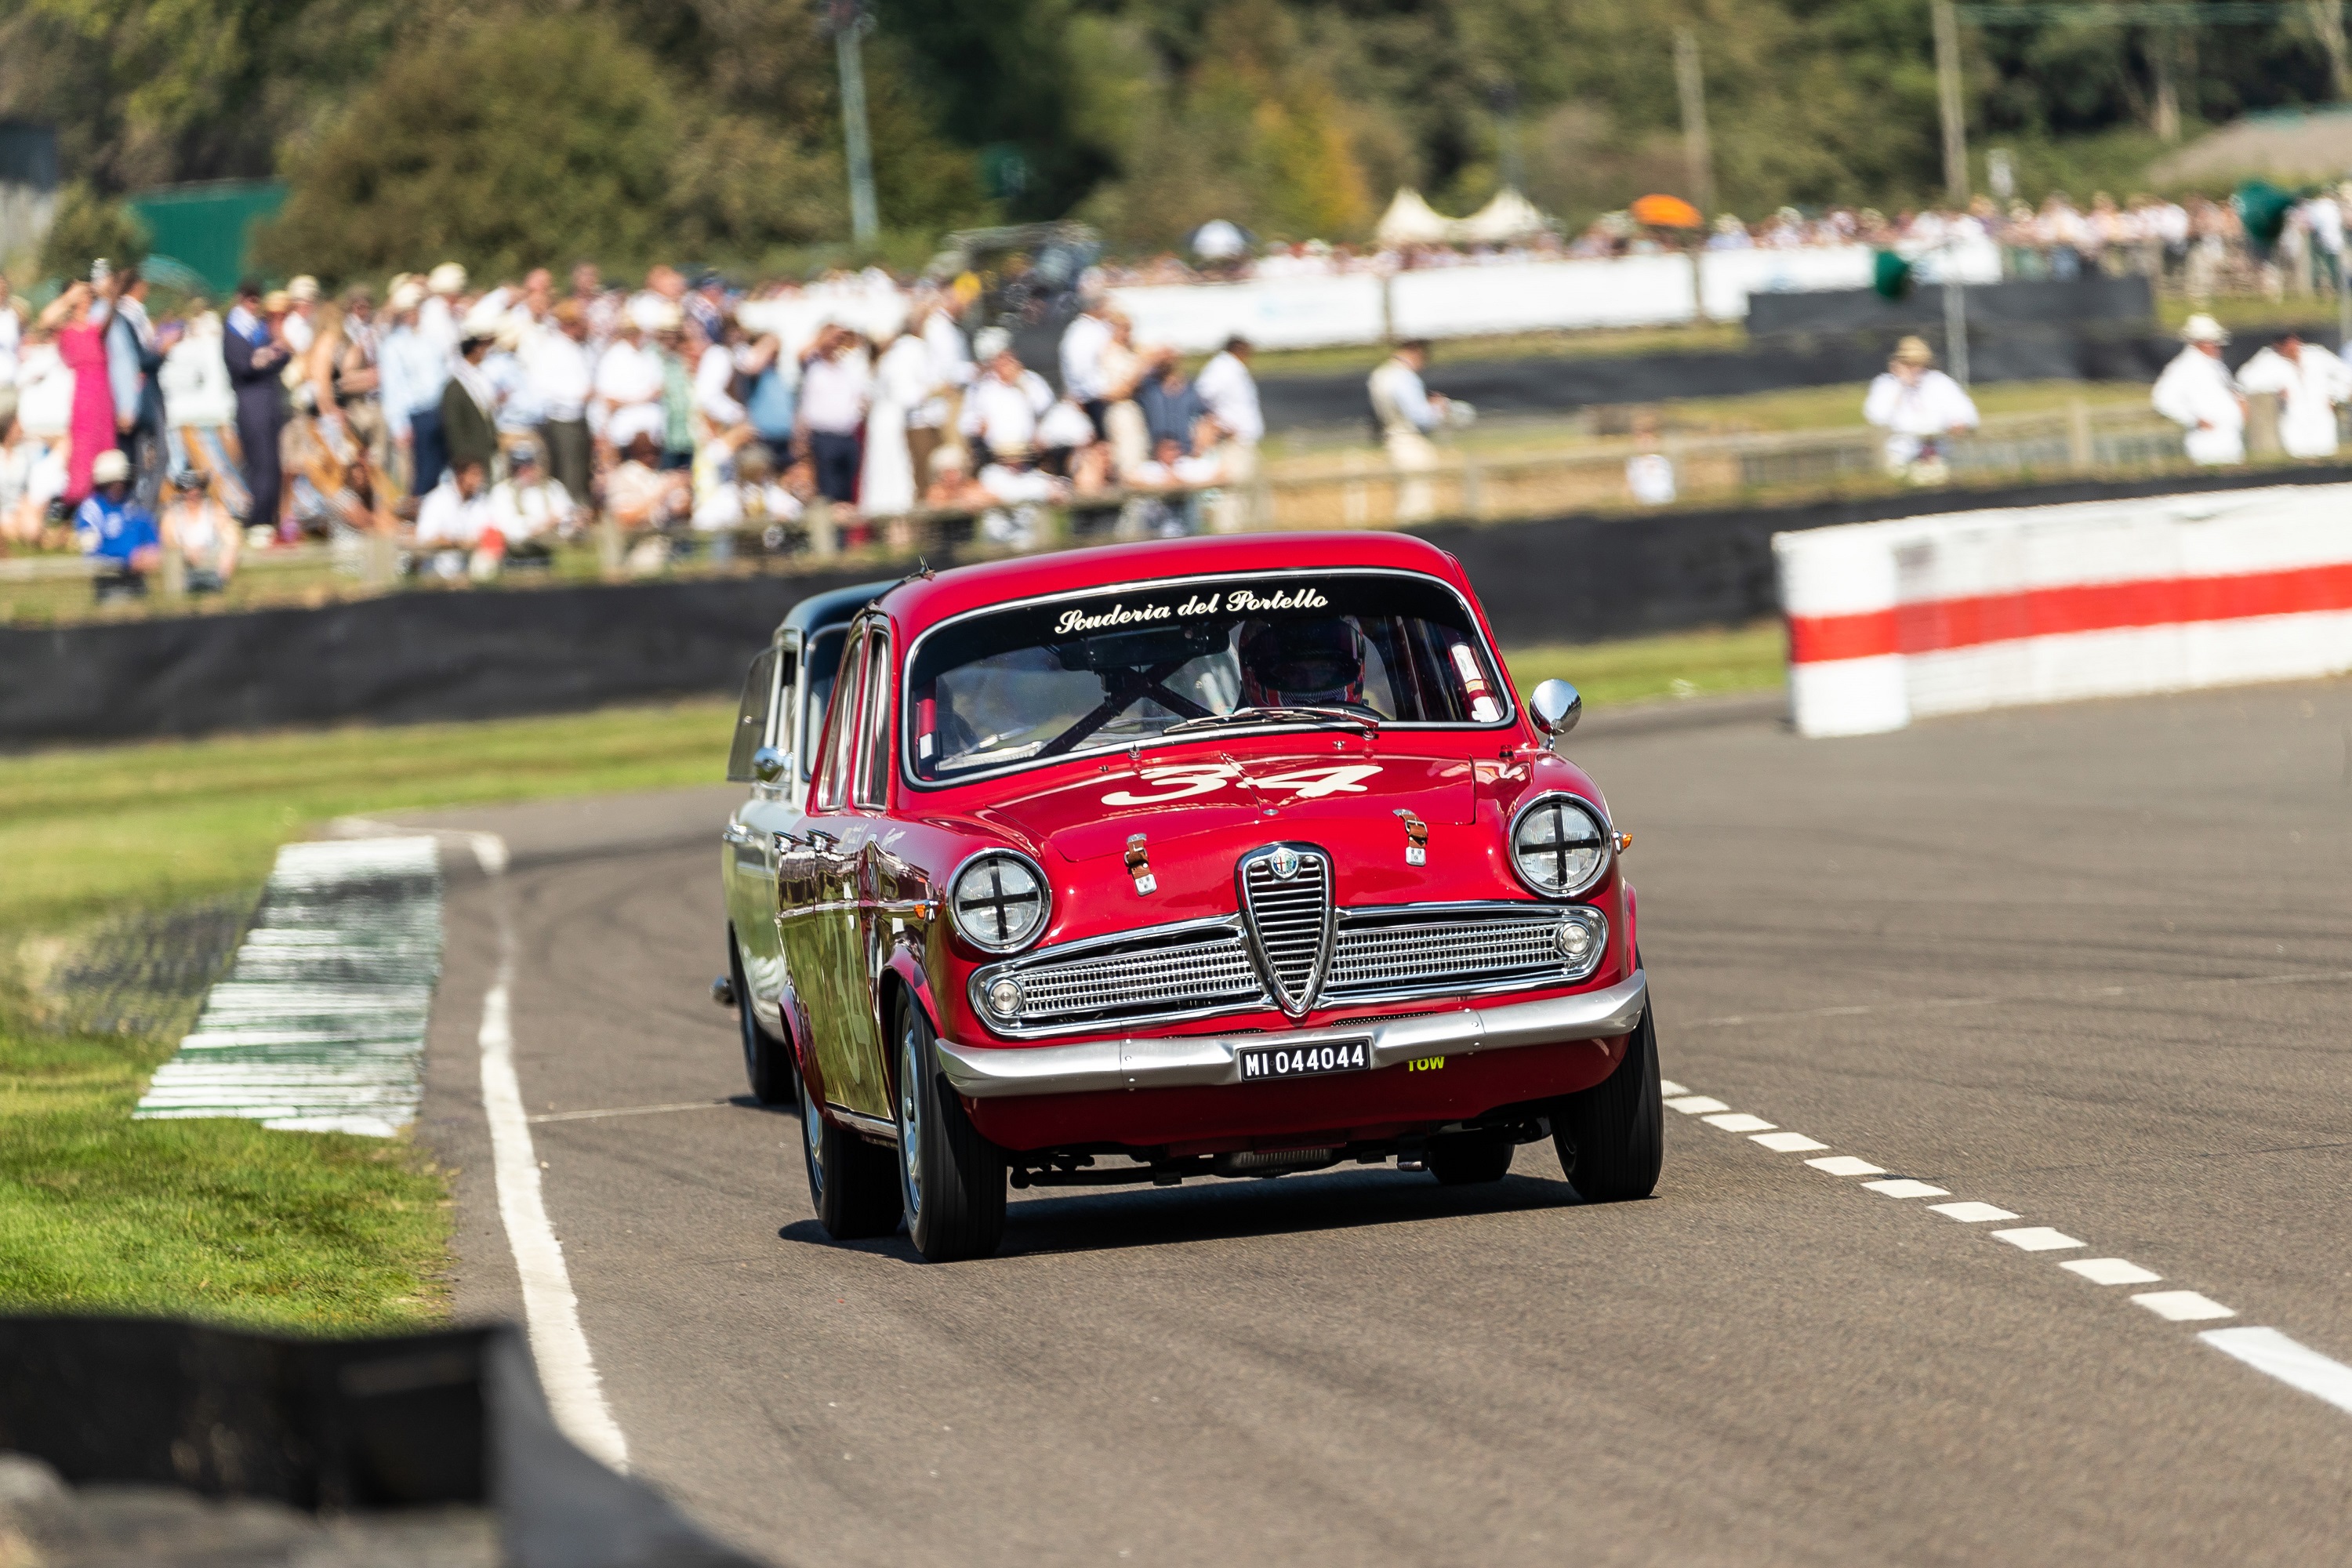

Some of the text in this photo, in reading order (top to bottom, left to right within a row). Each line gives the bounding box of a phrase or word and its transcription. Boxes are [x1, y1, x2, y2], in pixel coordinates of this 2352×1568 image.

[1054, 588, 1329, 634] Scuderia del Portello
[1100, 764, 1385, 806] 34
[1407, 1056, 1445, 1073] TOW
